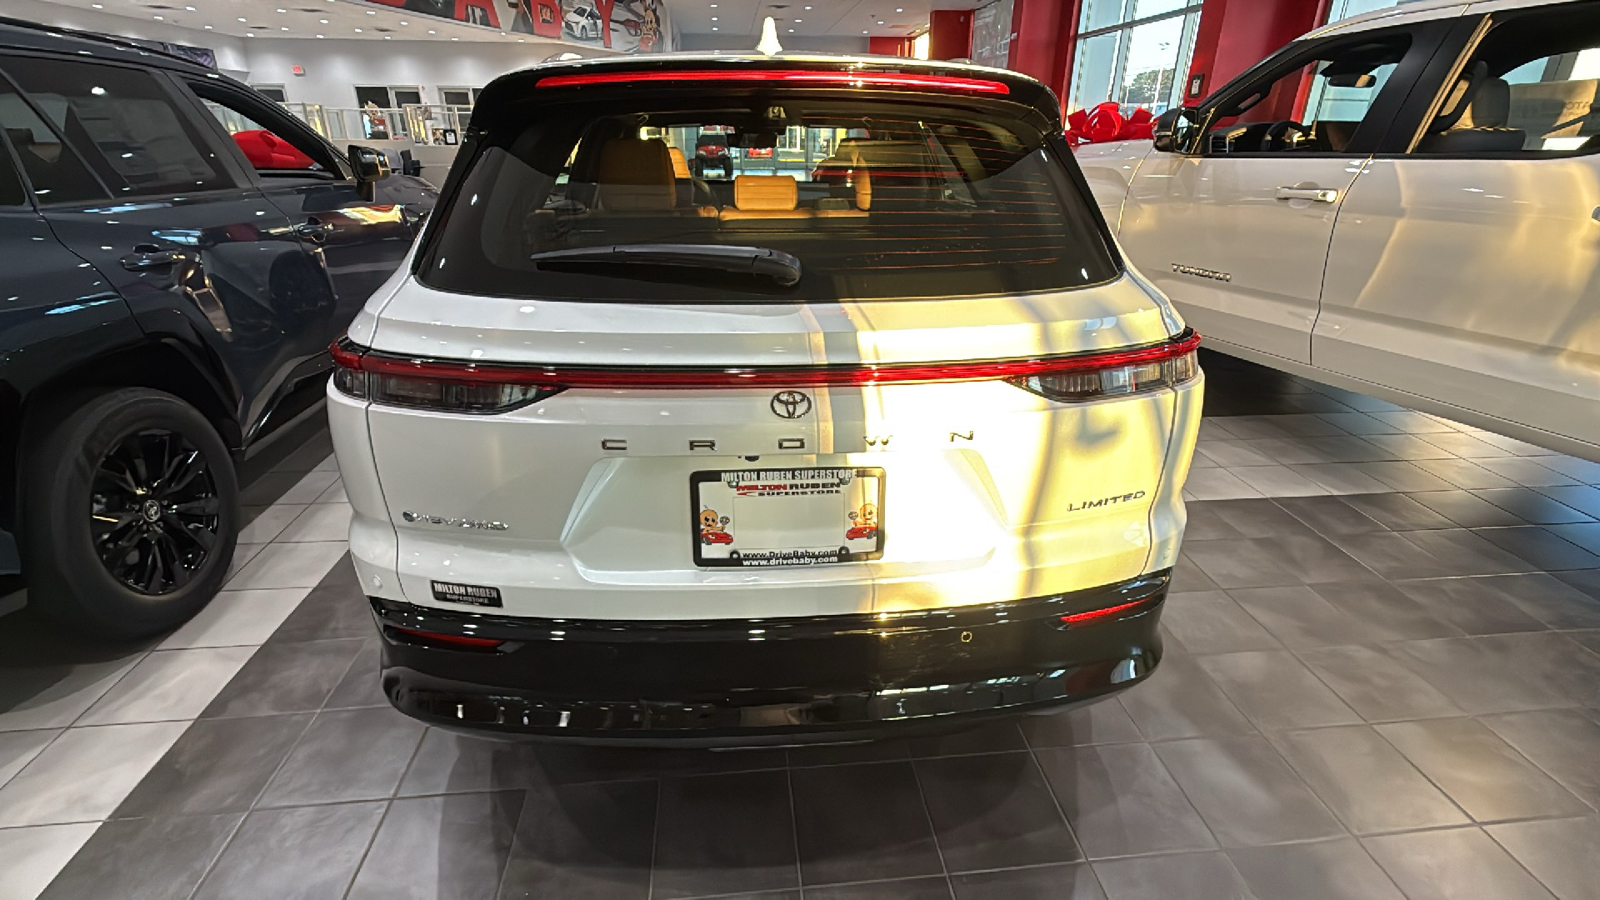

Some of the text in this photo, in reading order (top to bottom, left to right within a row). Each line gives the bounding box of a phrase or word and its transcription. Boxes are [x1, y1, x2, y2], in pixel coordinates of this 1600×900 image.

[1171, 263, 1231, 282] TUNDRA
[601, 430, 974, 451] CROWN
[721, 469, 857, 482] MILTON RUBEN SUPERSTORE
[789, 482, 840, 490] RUBEN
[1067, 490, 1146, 512] LIMITED
[742, 549, 838, 558] www.DriveBaby.com
[742, 556, 838, 567] www.drivebaby.com
[433, 582, 466, 595] MILTON
